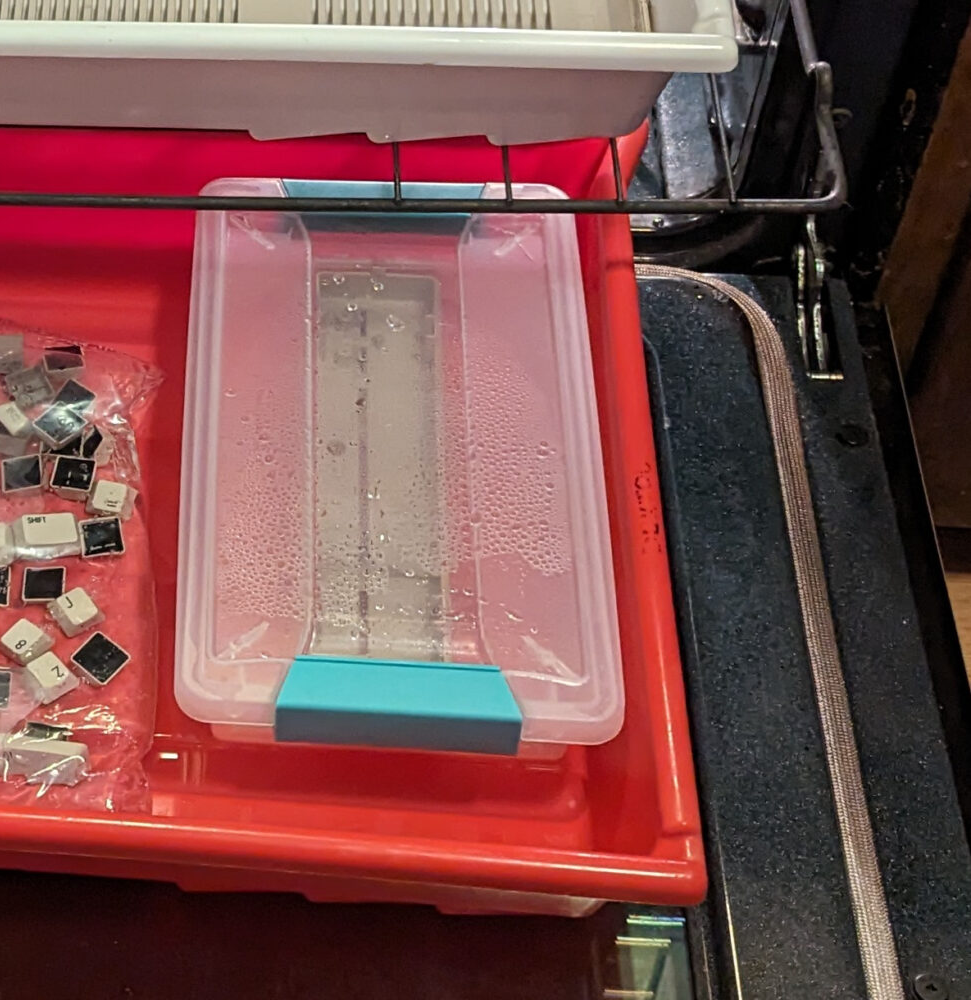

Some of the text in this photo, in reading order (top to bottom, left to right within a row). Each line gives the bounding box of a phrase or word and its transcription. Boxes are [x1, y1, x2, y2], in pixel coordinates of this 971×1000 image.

[27, 516, 46, 524] SHIFT
[65, 596, 74, 609] J
[14, 639, 27, 650] 8
